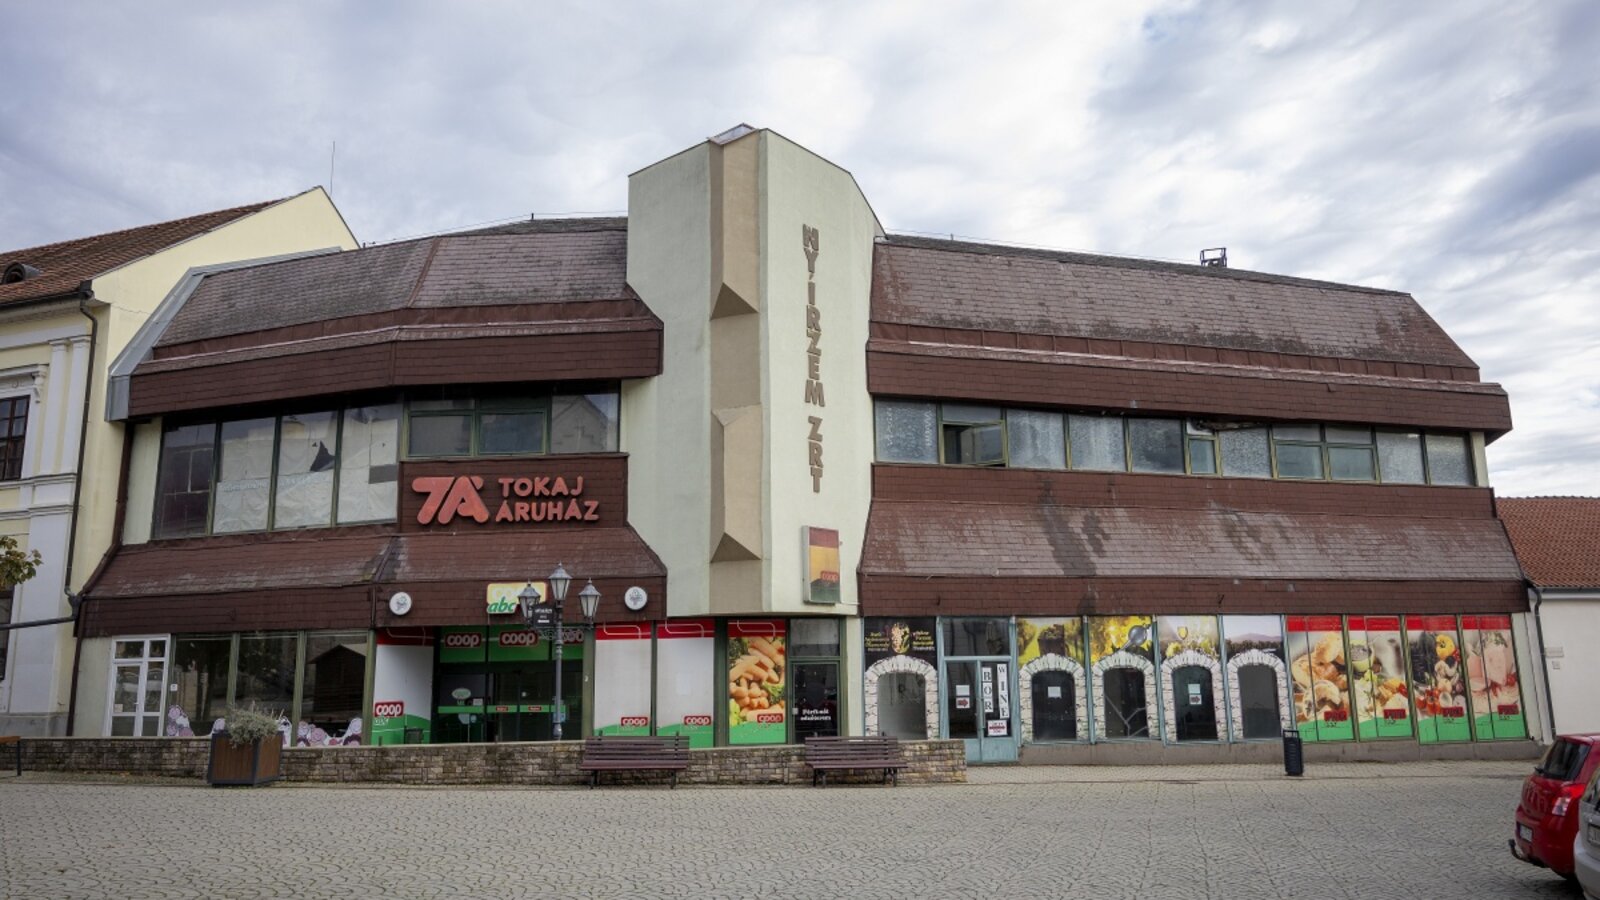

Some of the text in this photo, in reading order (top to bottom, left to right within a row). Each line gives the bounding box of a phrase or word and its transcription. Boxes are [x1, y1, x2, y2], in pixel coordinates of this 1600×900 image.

[808, 415, 823, 494] ZRT
[498, 476, 584, 497] TOKAJ
[495, 499, 600, 522] ÁRUHÁZ
[487, 595, 517, 613] abc
[998, 666, 1009, 717] WINE
